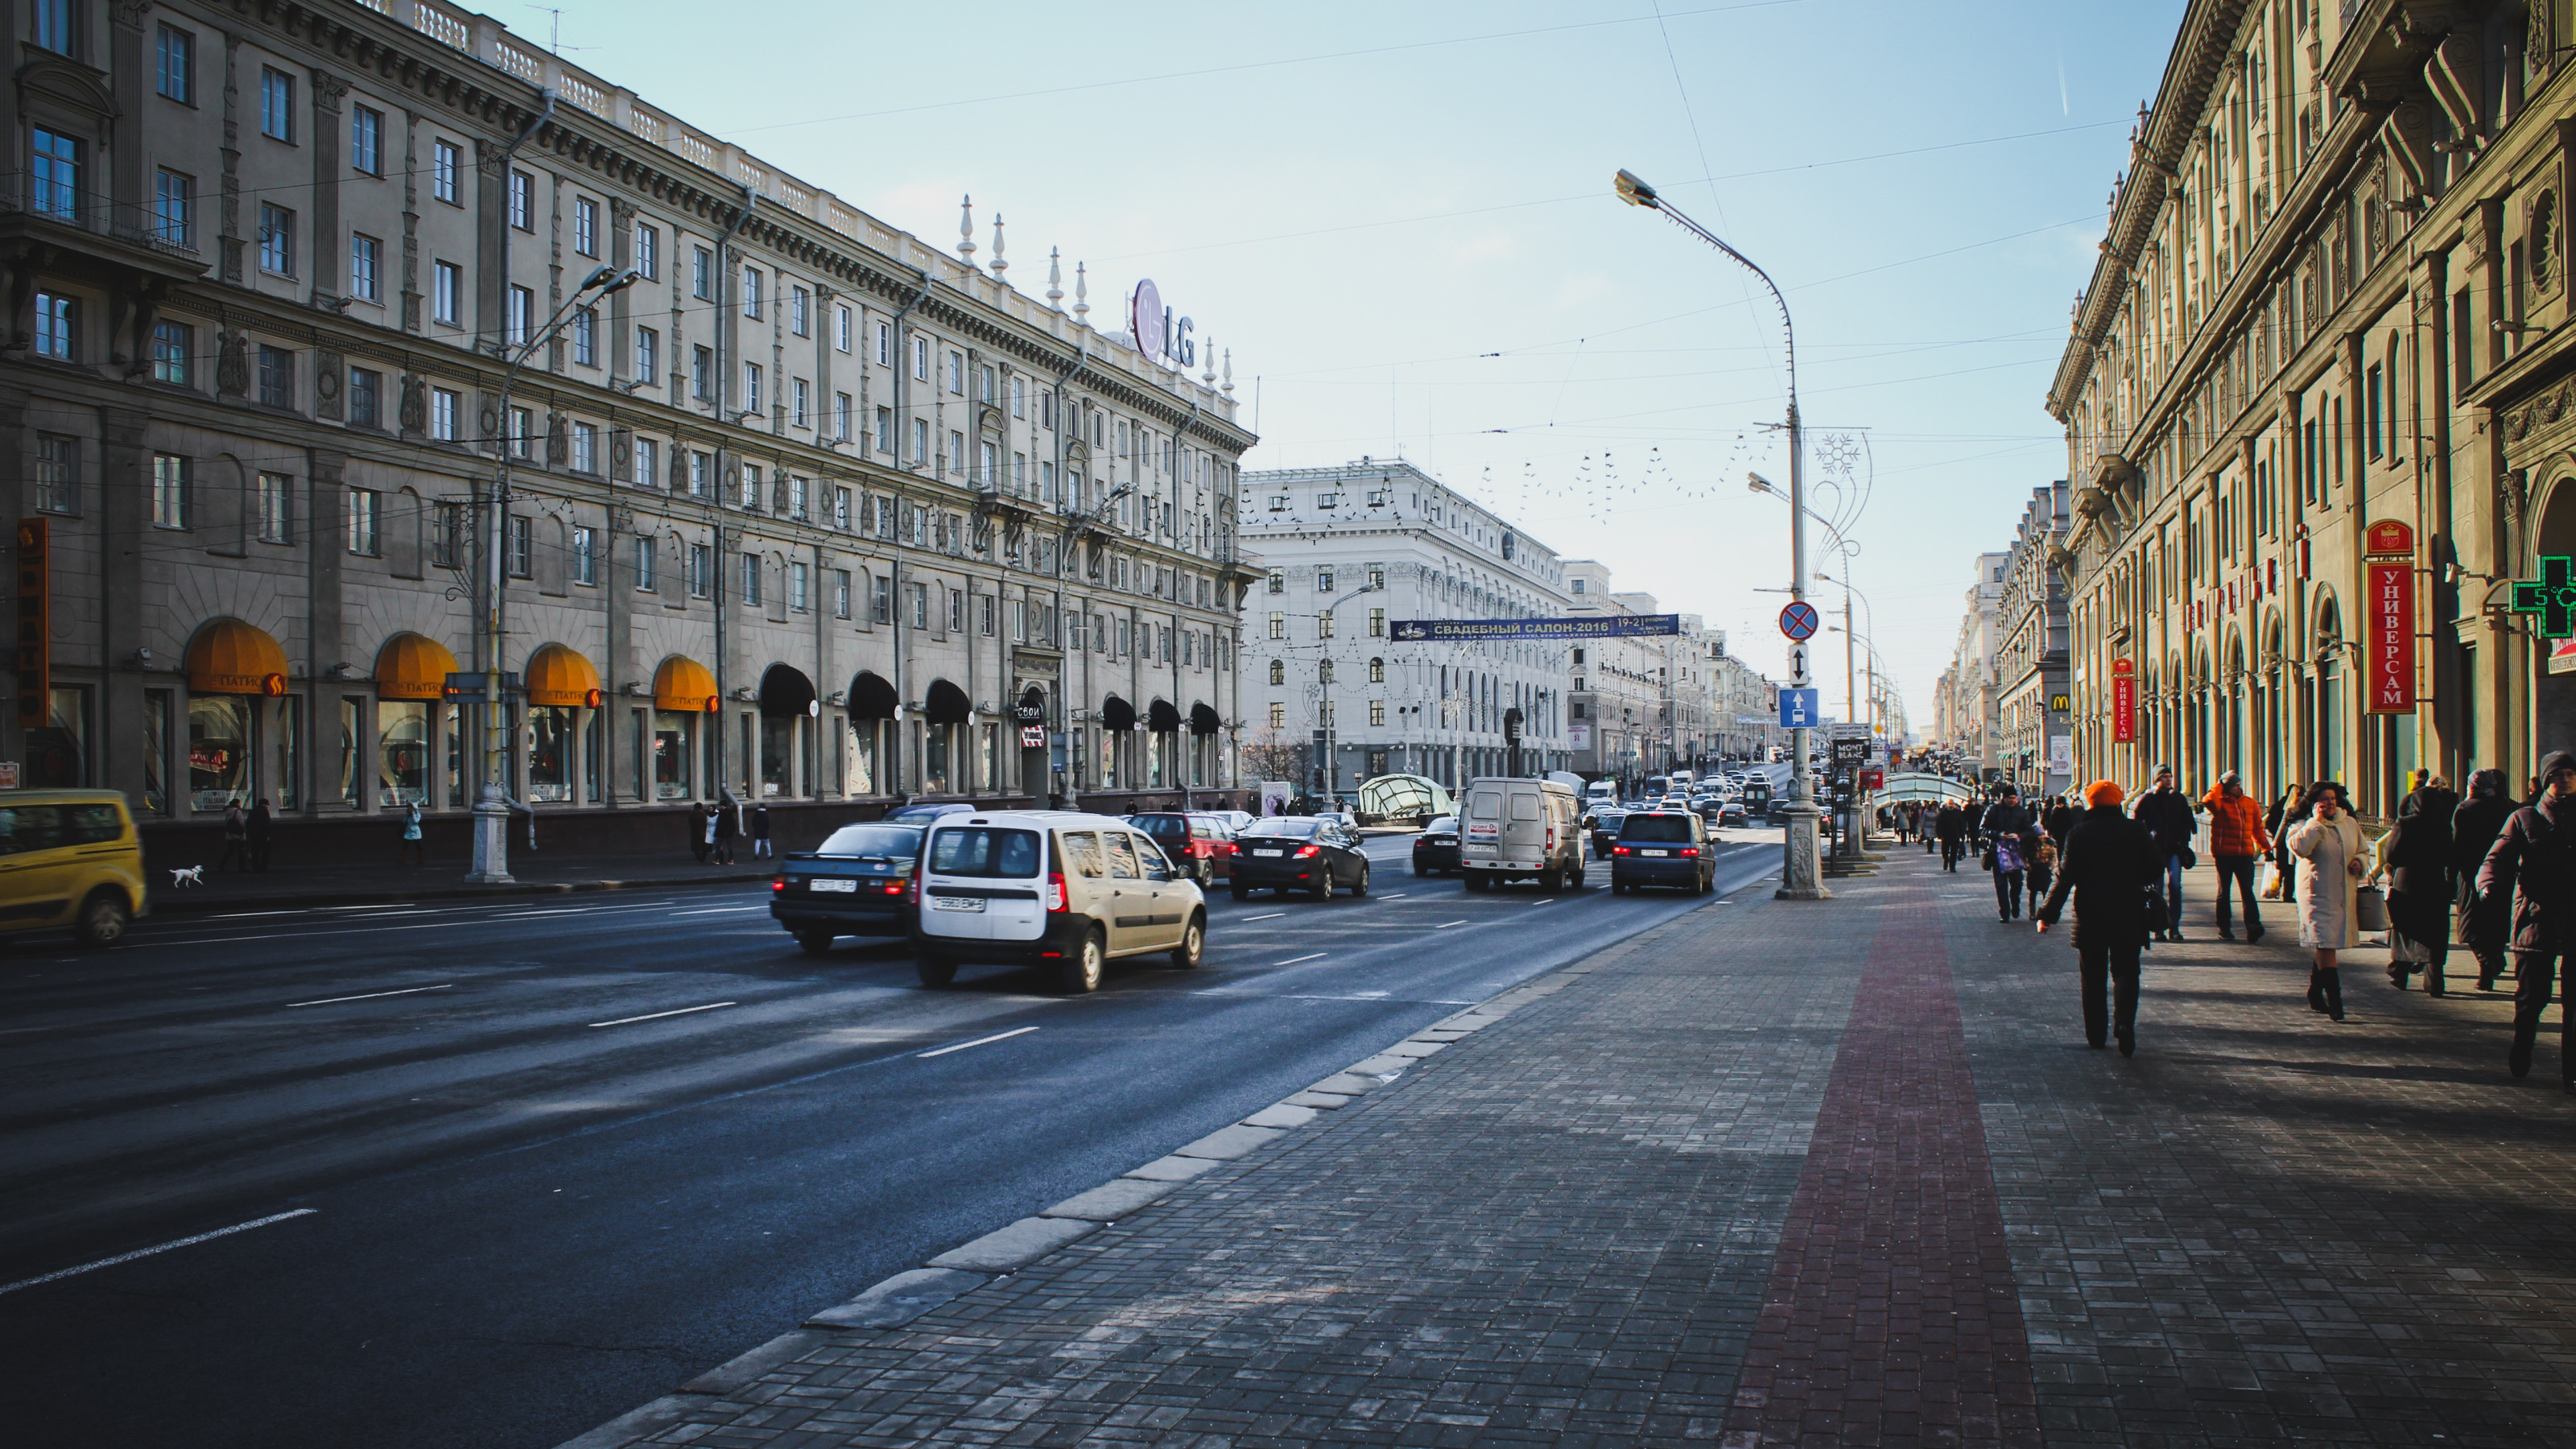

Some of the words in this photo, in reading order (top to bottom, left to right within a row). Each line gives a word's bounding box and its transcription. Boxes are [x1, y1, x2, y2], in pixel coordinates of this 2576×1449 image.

[1166, 306, 1194, 367] LG
[1435, 623, 1521, 634] СВАДЕБНЫЙ
[1525, 622, 1609, 634] САЛОН-2016
[1617, 617, 1644, 627] 19-21
[2383, 571, 2402, 704] УНИВЕРСАМ
[2119, 680, 2128, 739] УНИВЕРСАМ
